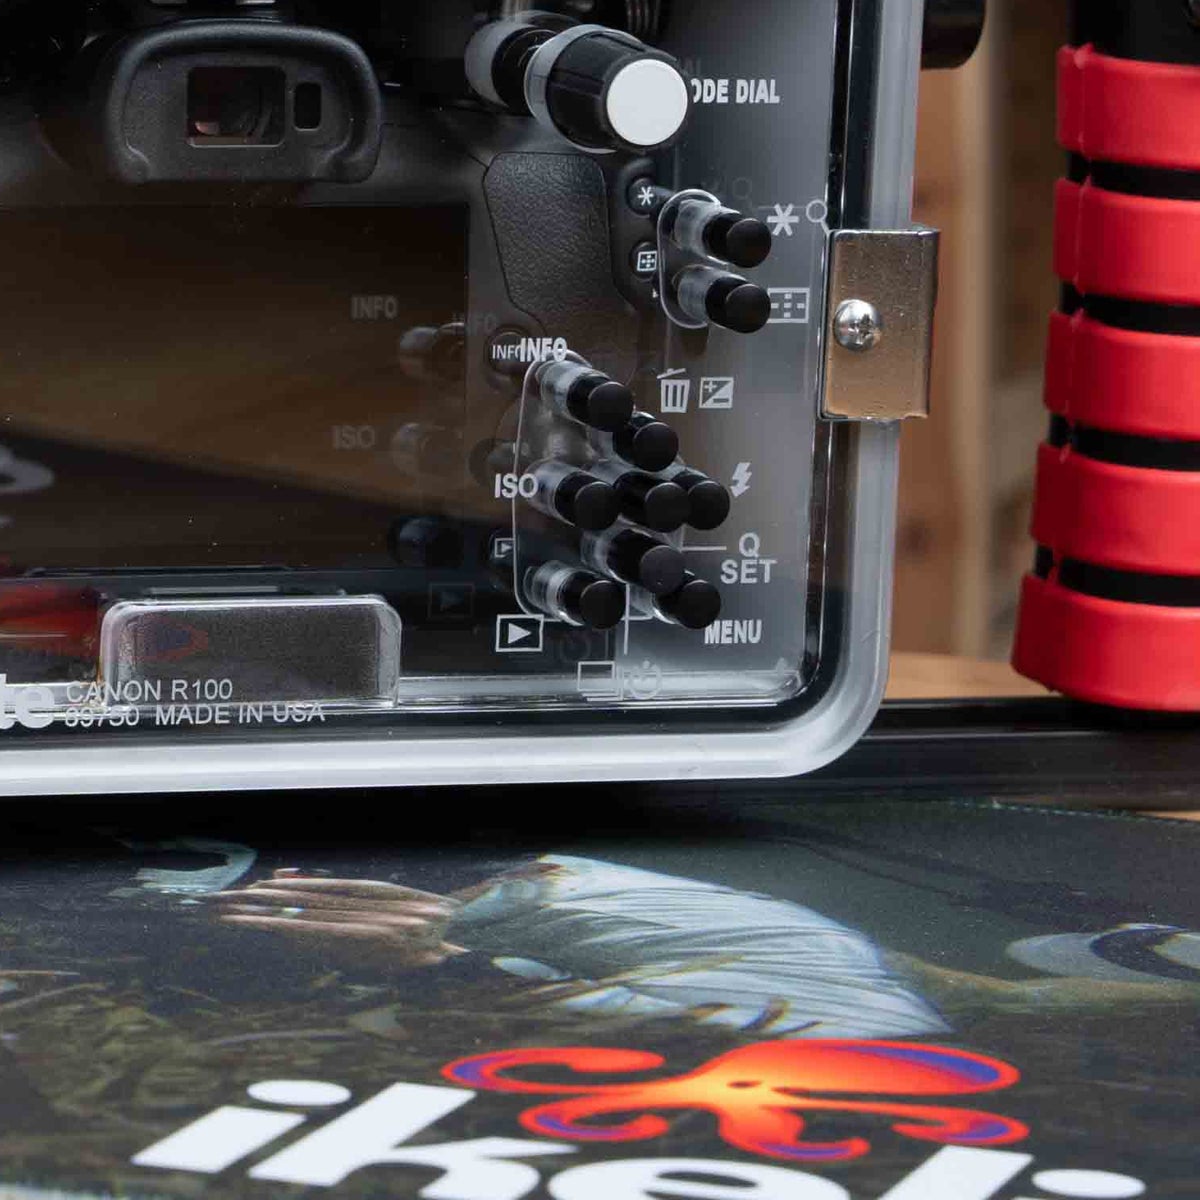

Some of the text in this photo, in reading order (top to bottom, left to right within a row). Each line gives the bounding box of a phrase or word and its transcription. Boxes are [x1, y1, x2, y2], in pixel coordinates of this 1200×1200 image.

[689, 77, 781, 104] ODE DIAL
[519, 336, 568, 362] INFO
[494, 473, 539, 499] ISO
[738, 531, 761, 558] Q
[720, 559, 778, 585] SET
[704, 619, 763, 644] MENU
[66, 678, 234, 703] CANON R100
[155, 703, 232, 726] MADE
[238, 702, 264, 724] IN
[272, 701, 327, 724] USA
